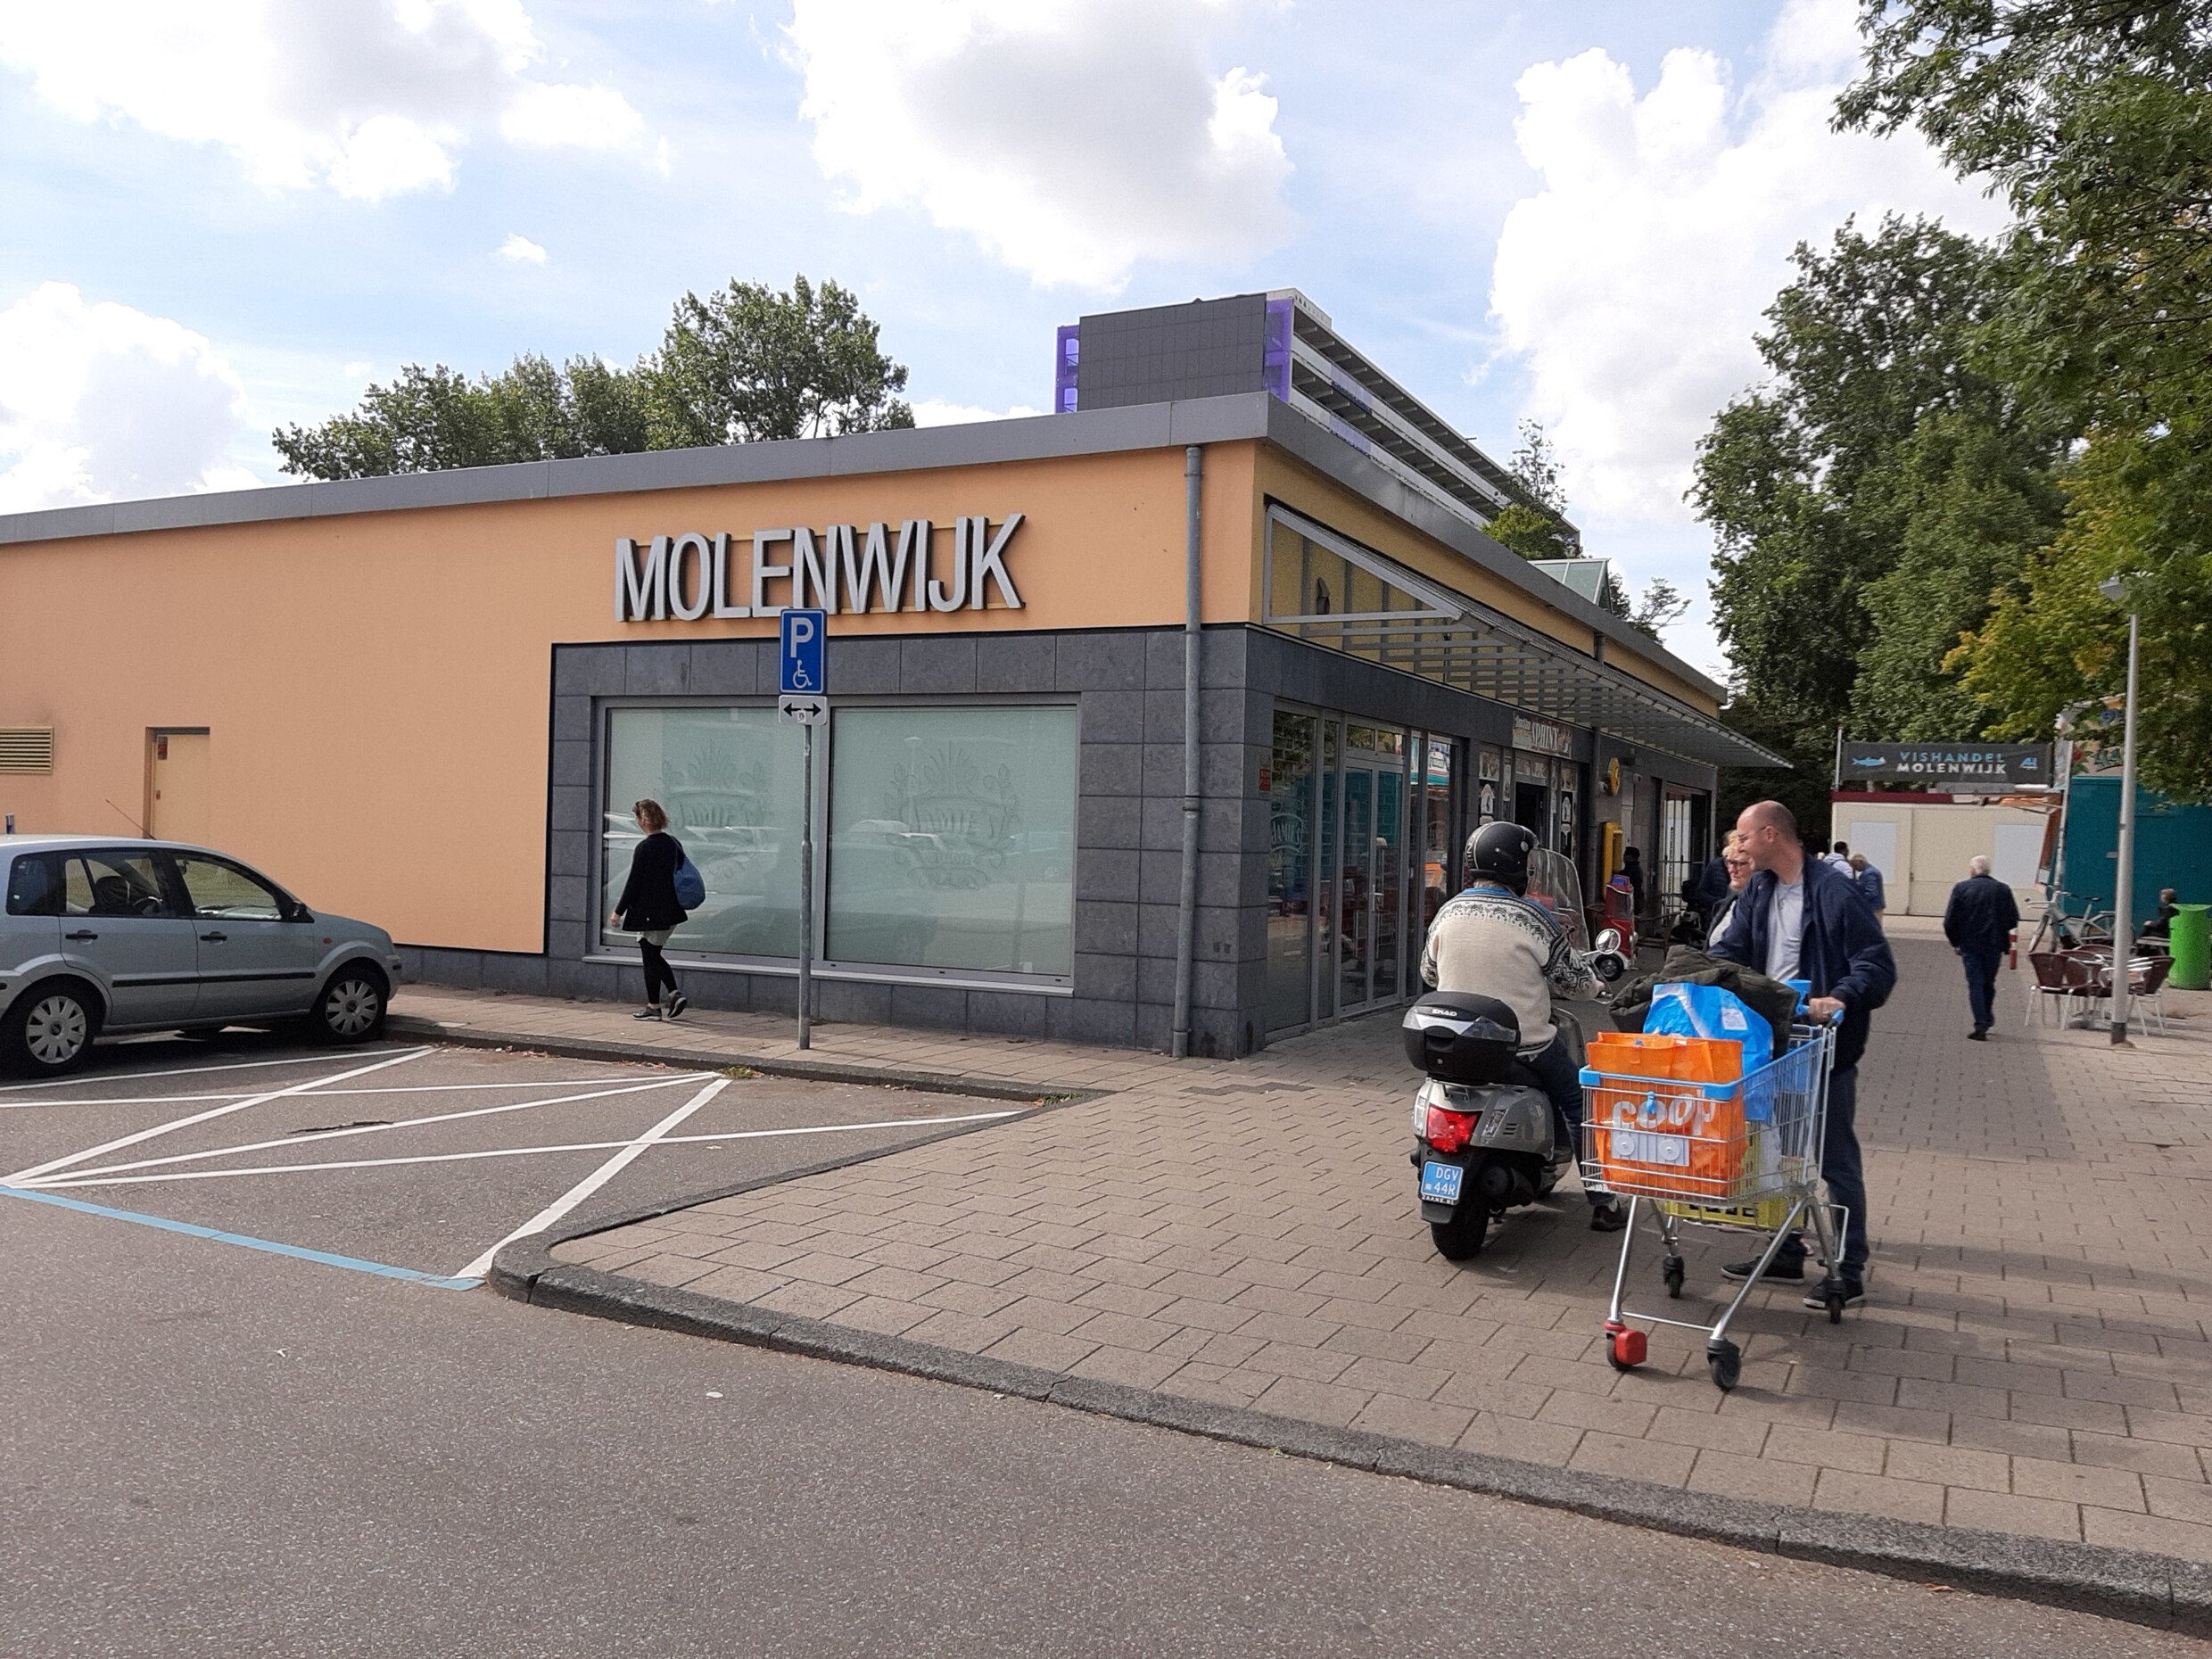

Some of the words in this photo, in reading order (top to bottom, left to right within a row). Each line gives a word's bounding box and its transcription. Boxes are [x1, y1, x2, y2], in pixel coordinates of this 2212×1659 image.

[615, 514, 1025, 622] MOLENWIJK
[790, 617, 813, 658] P
[1900, 752, 2005, 763] VISHANDEL
[1896, 763, 2006, 774] MOLENWIJK
[1436, 1167, 1459, 1181] DGV
